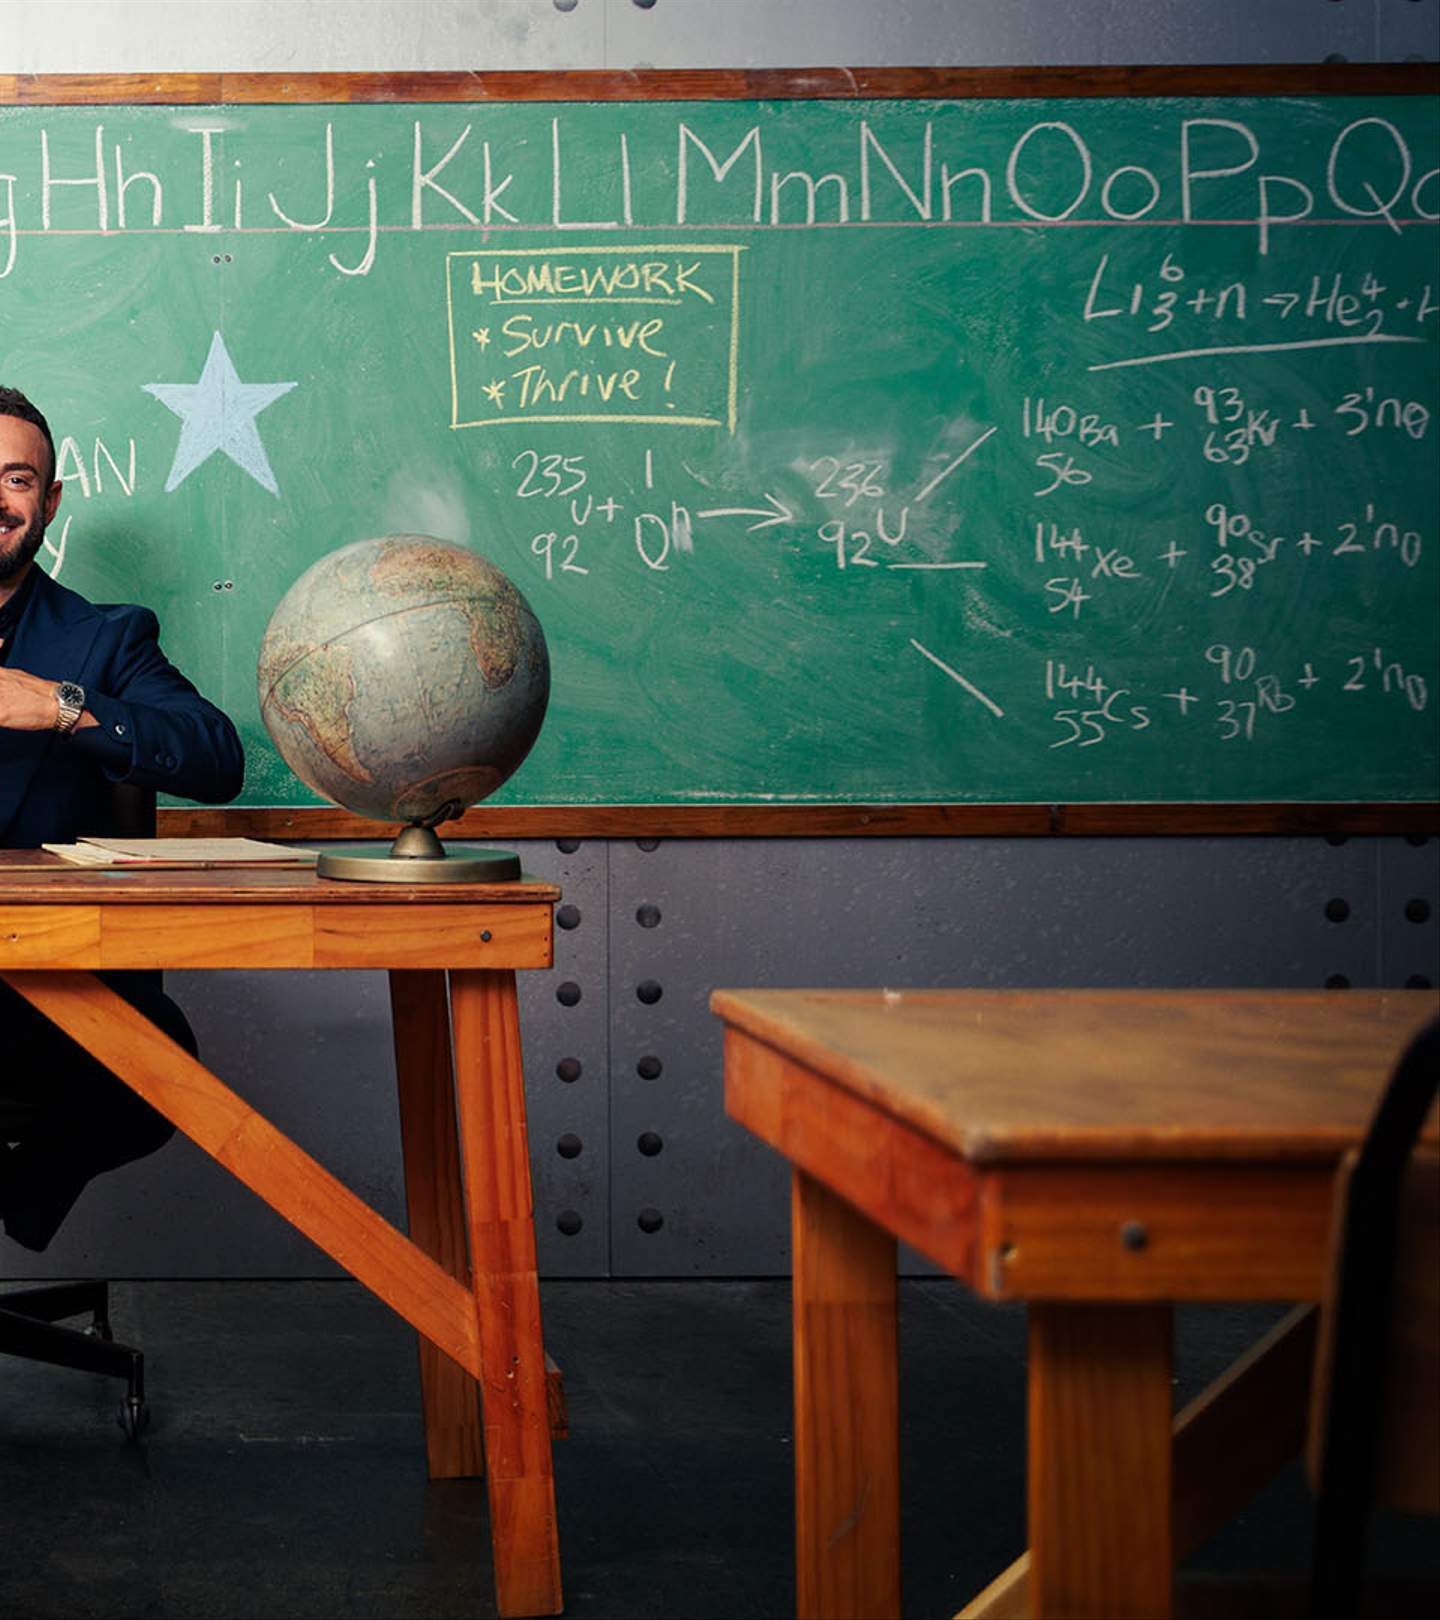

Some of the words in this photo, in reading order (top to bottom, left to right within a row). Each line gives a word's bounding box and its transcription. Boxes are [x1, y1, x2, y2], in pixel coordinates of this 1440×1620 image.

[41, 125, 162, 231] Hh
[184, 128, 242, 232] Ii
[269, 123, 377, 275] Jj
[412, 121, 519, 229] Kk
[676, 124, 849, 225] Mm
[860, 121, 992, 222] Nn
[1006, 121, 1160, 222] Oo
[1181, 118, 1313, 254] Pp
[472, 261, 713, 301] HOMEWORK
[502, 315, 667, 357] Survive
